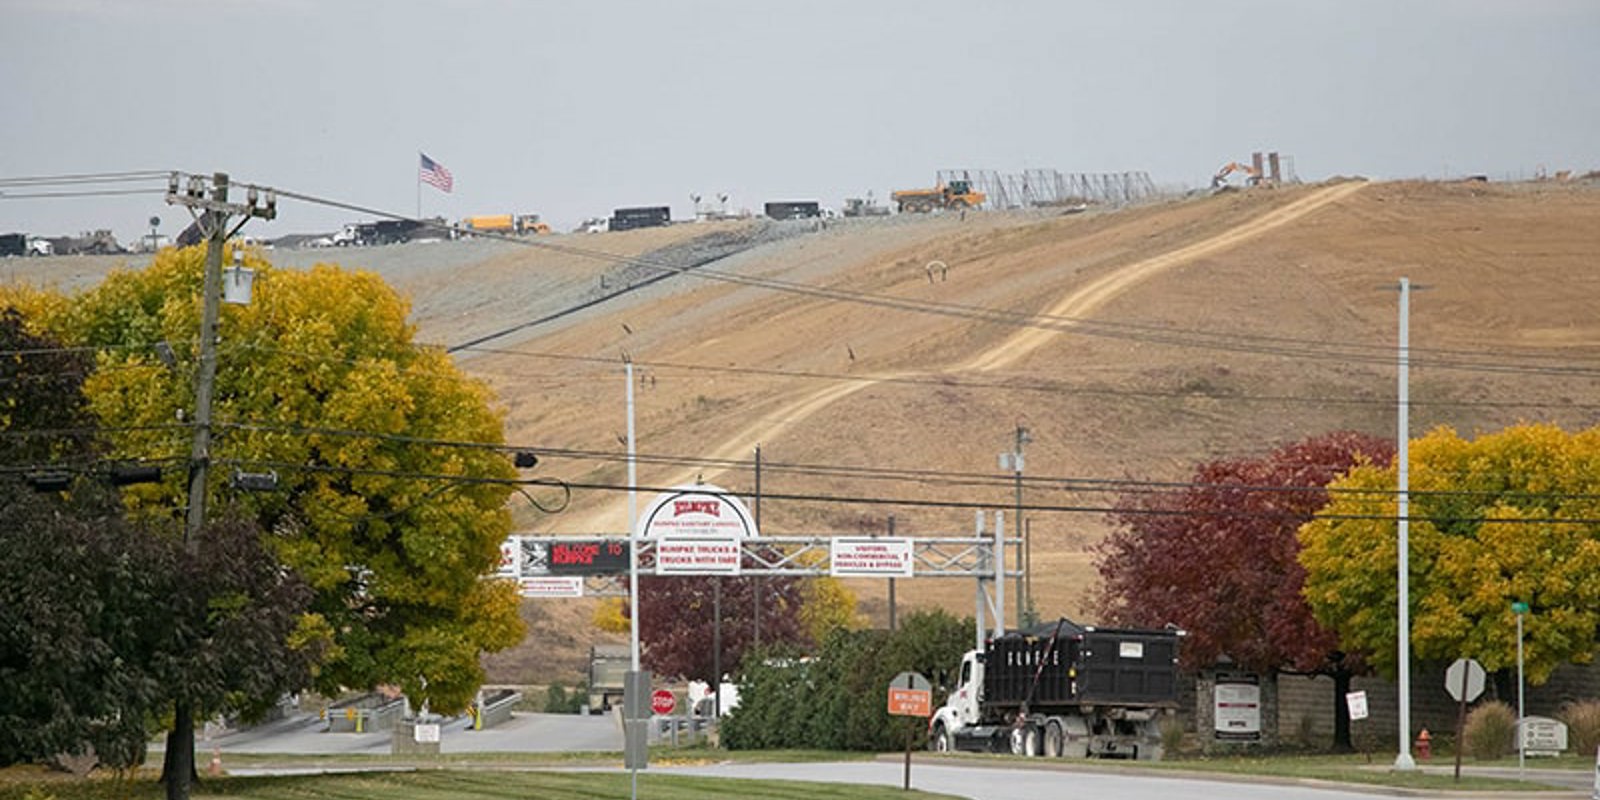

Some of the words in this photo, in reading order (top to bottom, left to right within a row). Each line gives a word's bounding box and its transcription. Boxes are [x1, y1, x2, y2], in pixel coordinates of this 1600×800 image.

[552, 543, 598, 555] WELCOME
[607, 543, 623, 555] TO
[1007, 650, 1059, 666] RUMPE
[652, 696, 673, 707] STOP
